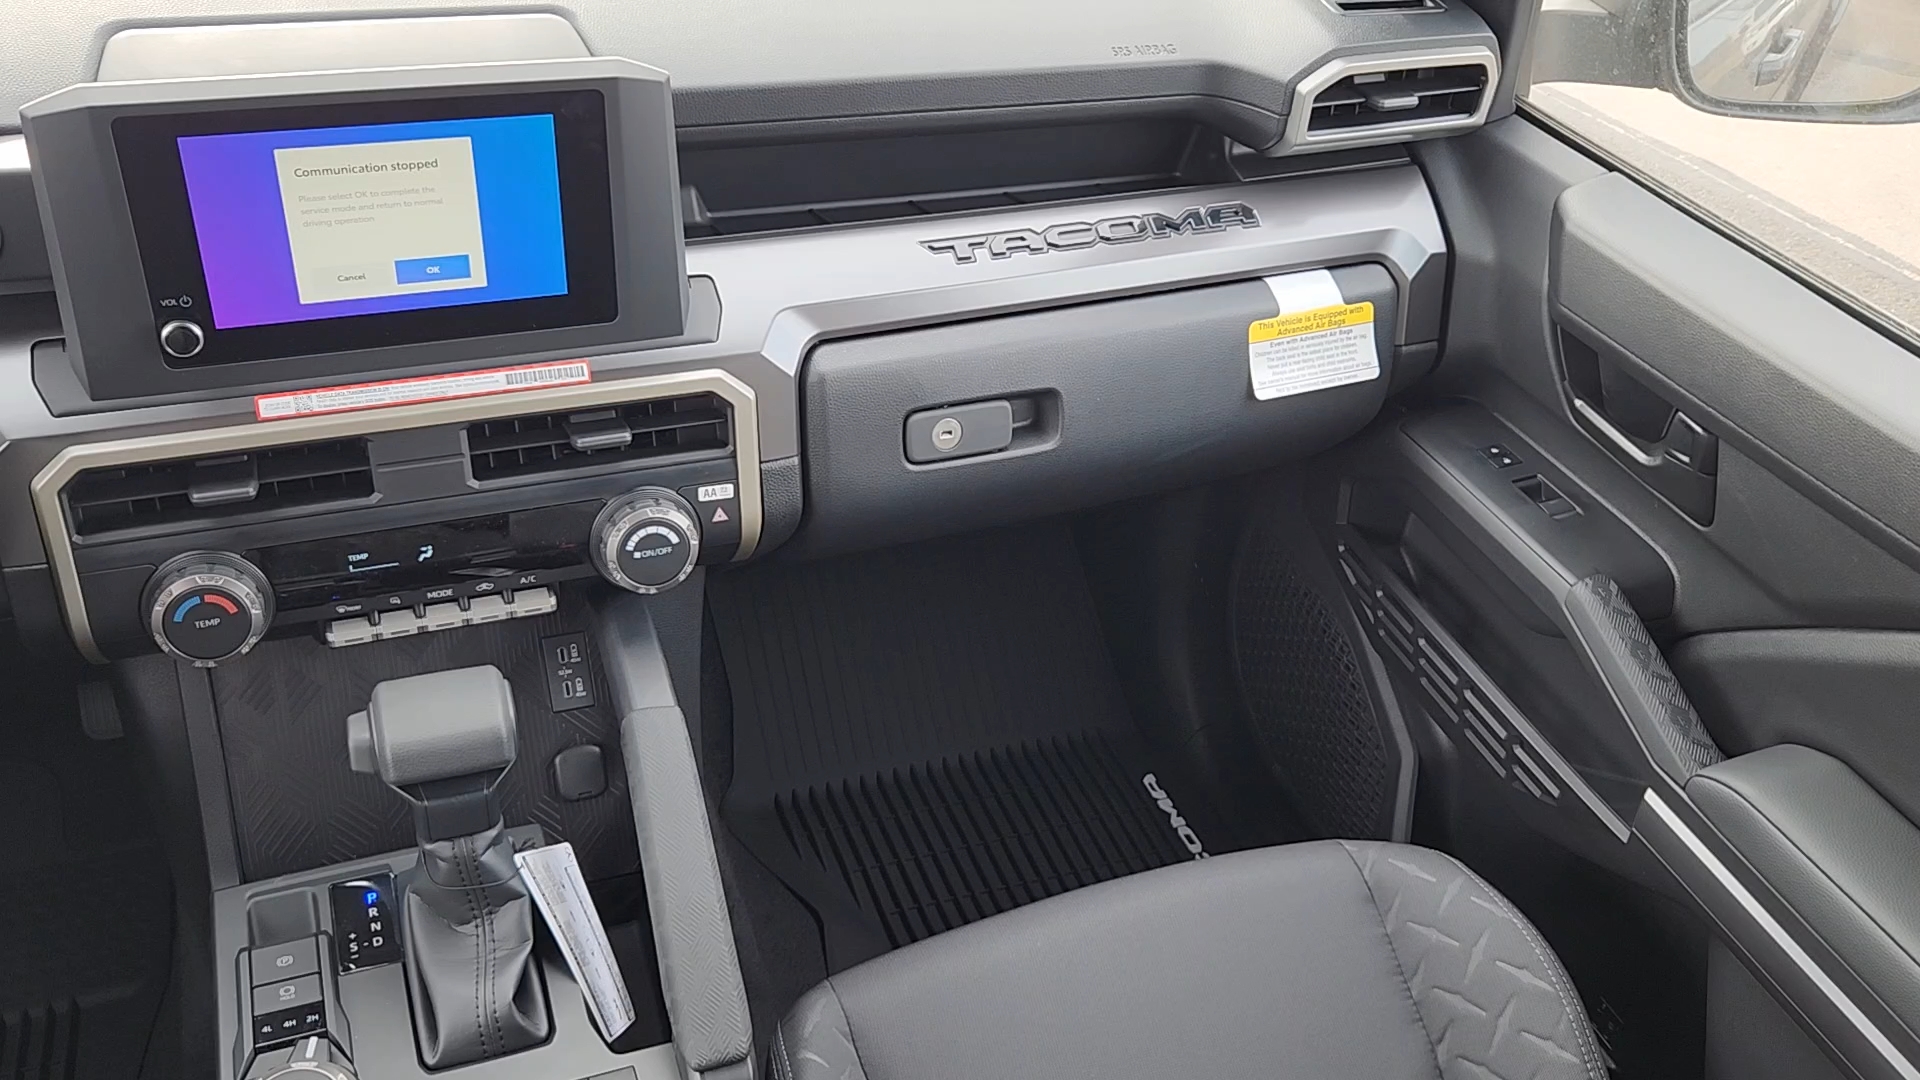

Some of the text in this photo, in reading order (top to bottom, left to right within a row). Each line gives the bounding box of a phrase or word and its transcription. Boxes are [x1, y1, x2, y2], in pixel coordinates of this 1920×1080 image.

[1111, 43, 1178, 56] SRS AIRBAG
[293, 158, 439, 178] Communication stopped
[298, 186, 436, 203] Please select OK to complete the
[300, 207, 330, 215] service
[331, 204, 357, 212] mode
[358, 203, 375, 211] and
[414, 198, 444, 207] normal
[302, 220, 332, 228] driving
[917, 201, 1263, 265] TACOMA
[425, 265, 441, 274] OK
[337, 272, 366, 282] Cancel
[160, 298, 178, 307] VOL
[1258, 306, 1364, 331] This Vehicle is Equipped with
[1276, 318, 1346, 337] Advanced Air Bags
[1299, 332, 1328, 342] Advanced
[703, 487, 717, 499] AA
[347, 553, 369, 562] TEMP
[641, 546, 673, 558] ON/OFF
[520, 575, 537, 584] A/C
[426, 588, 454, 600] MODE
[194, 617, 221, 629] TEMP
[1142, 773, 1211, 861] OMA
[366, 892, 378, 905] P
[368, 907, 379, 918] R
[370, 921, 382, 932] N
[349, 942, 359, 953] S
[372, 936, 384, 947] D
[261, 1013, 319, 1033] 4L 4H 2H
